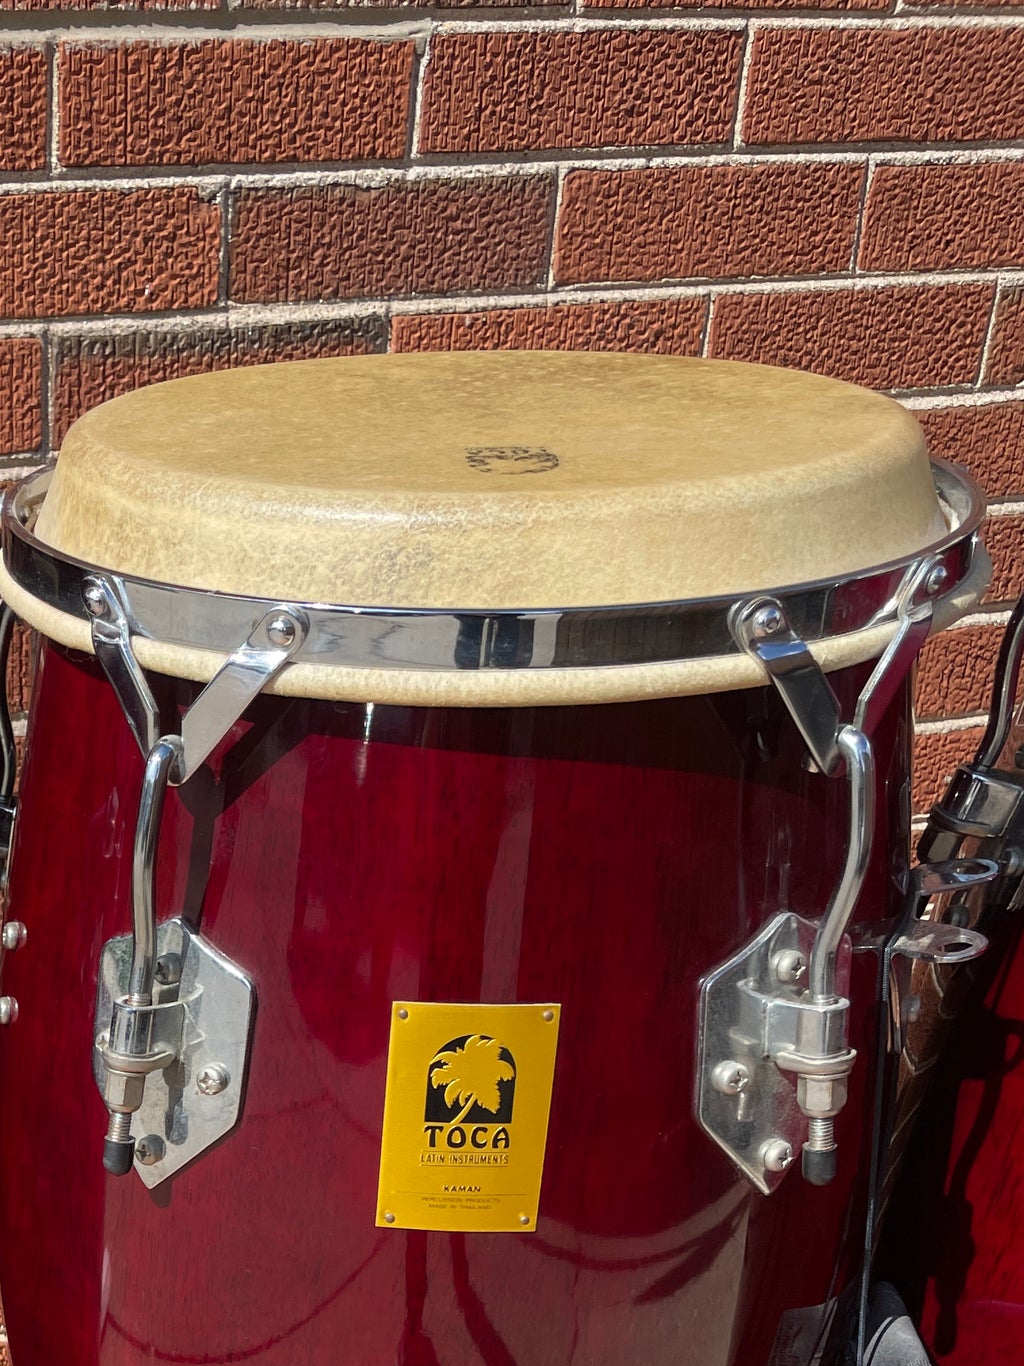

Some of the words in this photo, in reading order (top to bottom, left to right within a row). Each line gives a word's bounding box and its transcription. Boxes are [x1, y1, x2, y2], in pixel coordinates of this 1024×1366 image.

[424, 1125, 510, 1149] TOCA
[420, 1153, 445, 1164] LATIN
[449, 1154, 509, 1165] INSTRUMENTS
[443, 1185, 481, 1193] KAMAN
